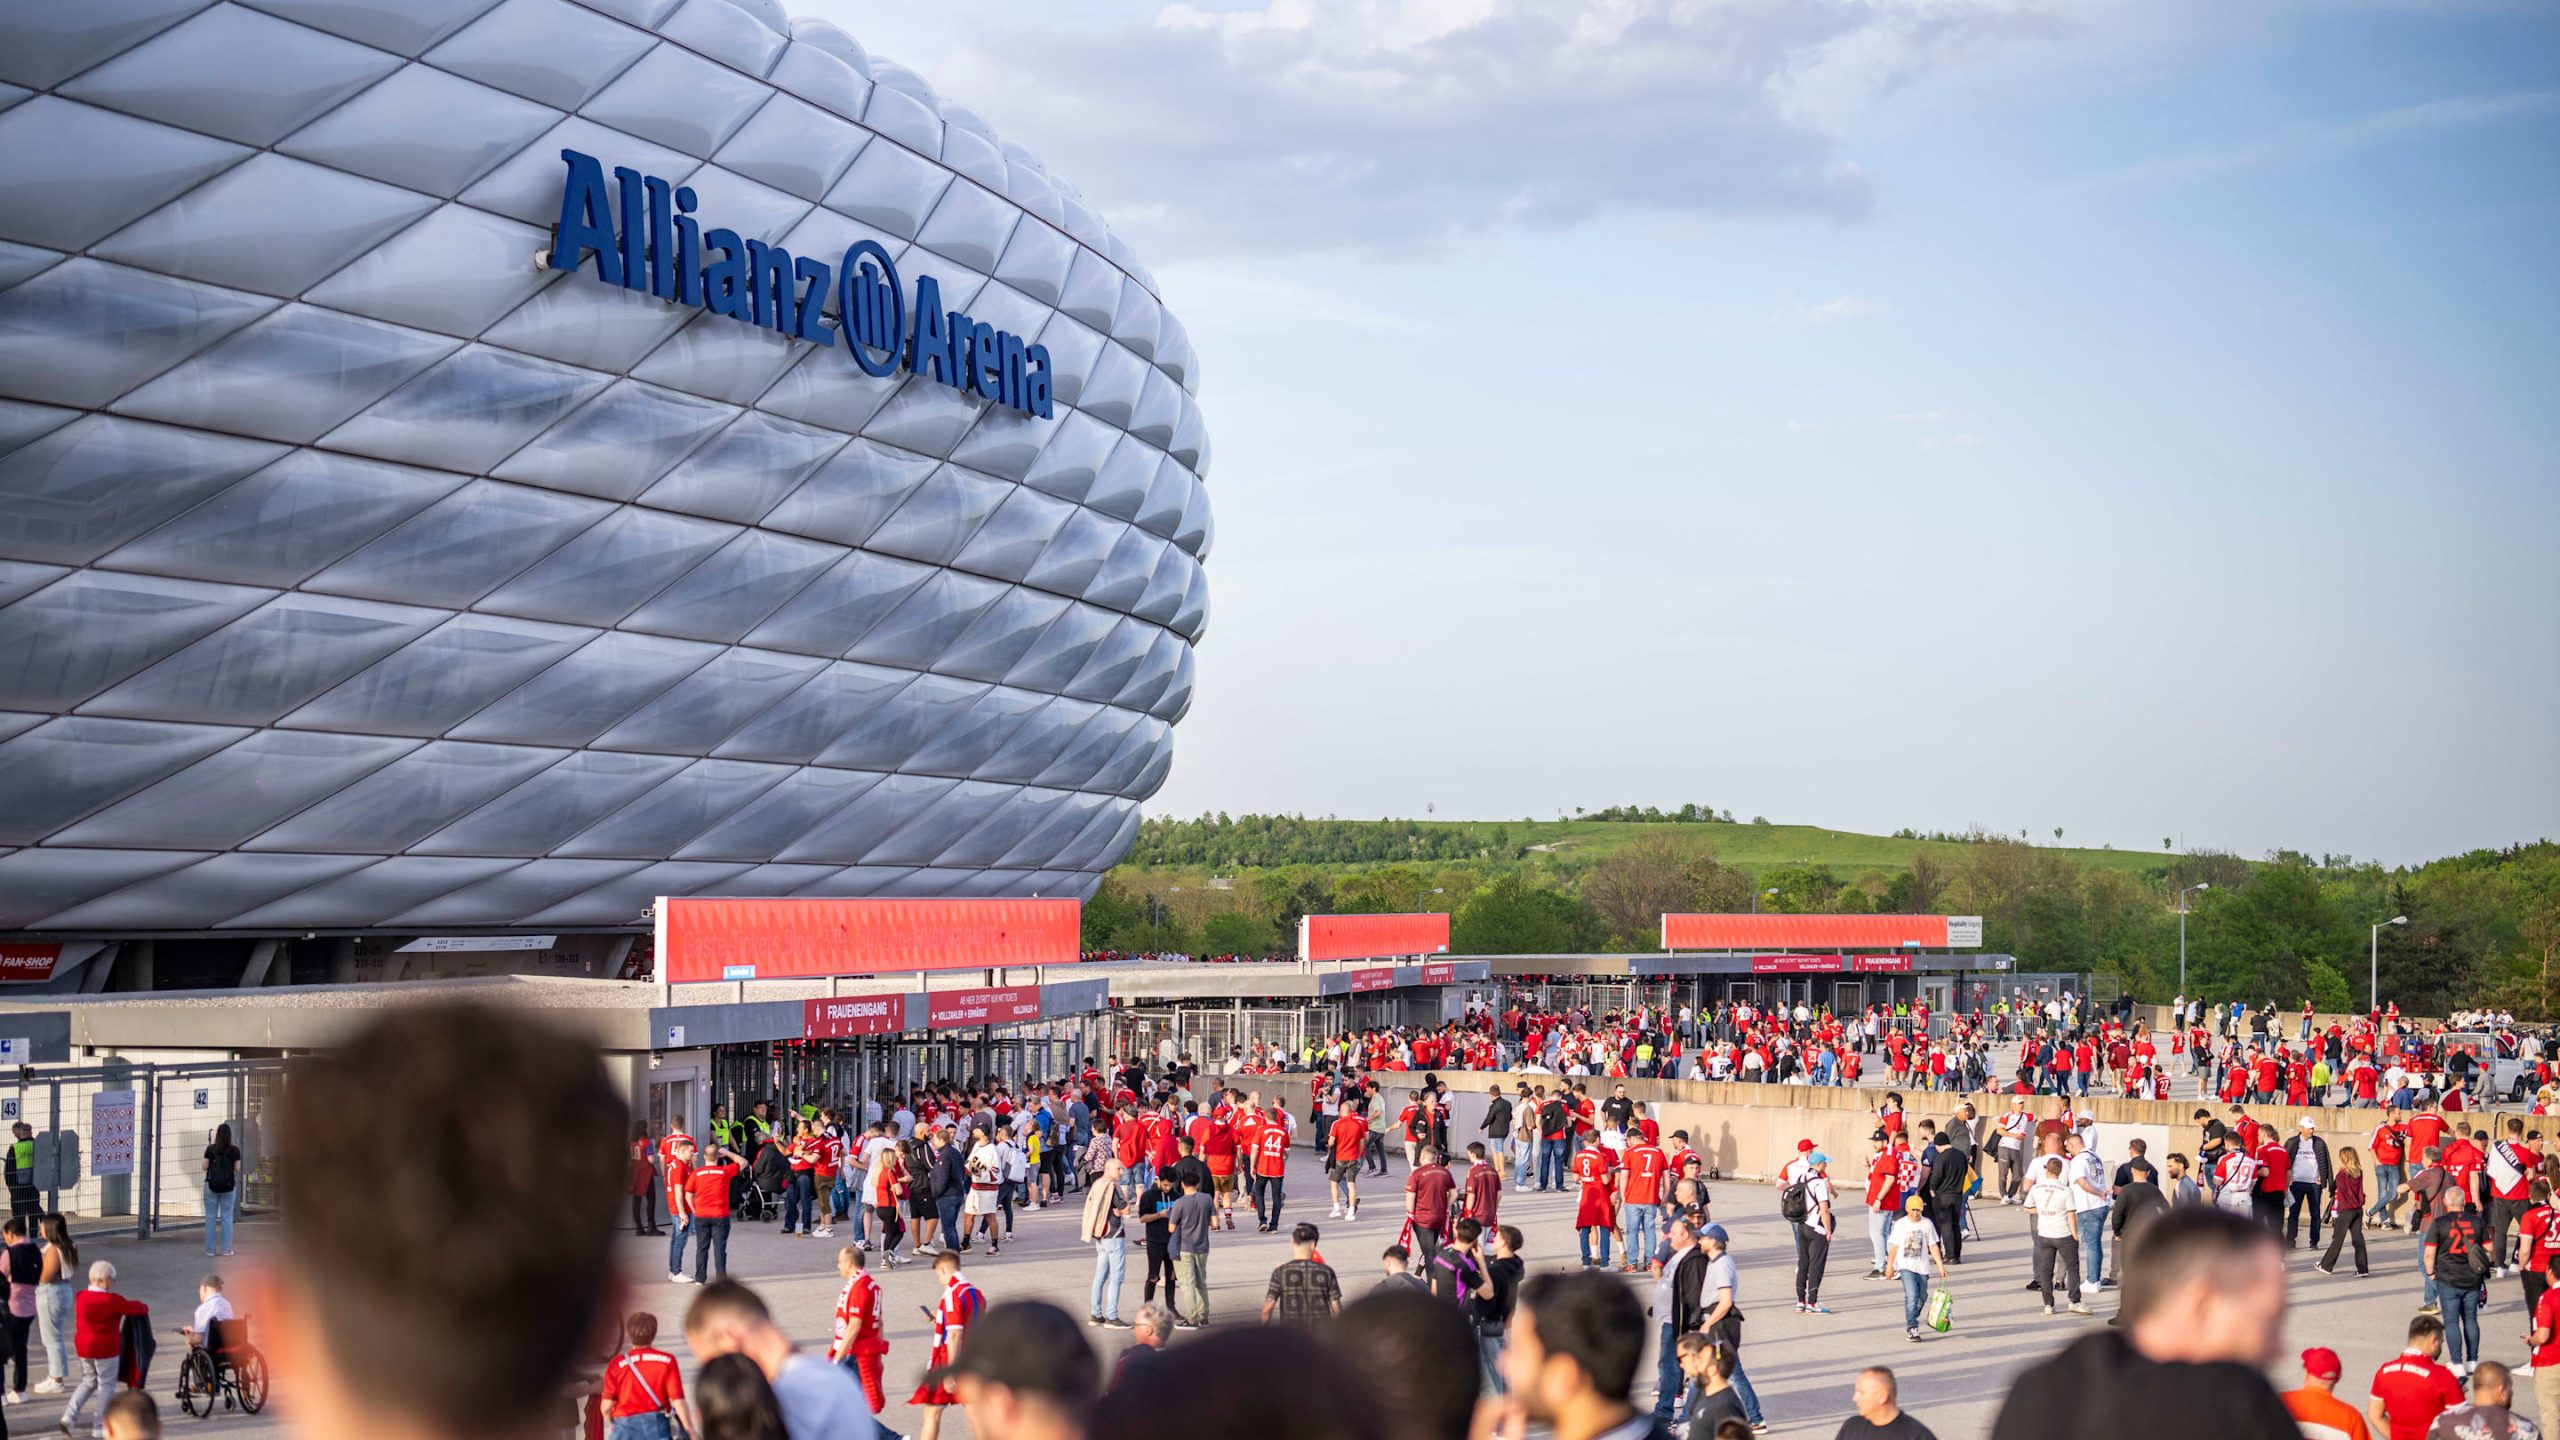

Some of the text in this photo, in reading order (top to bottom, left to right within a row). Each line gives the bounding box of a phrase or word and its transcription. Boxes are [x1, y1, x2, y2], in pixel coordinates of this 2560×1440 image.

[552, 148, 1054, 421] Allianz Arena
[3, 957, 53, 967] FAN-SHOP
[827, 1001, 888, 1020] FRAUENEINGANG
[196, 1092, 207, 1105] 42
[4, 1102, 16, 1115] 43
[1264, 1135, 1282, 1152] 44
[1582, 1159, 1590, 1176] 8
[1643, 1154, 1652, 1171] 7
[2045, 1190, 2054, 1208] 7
